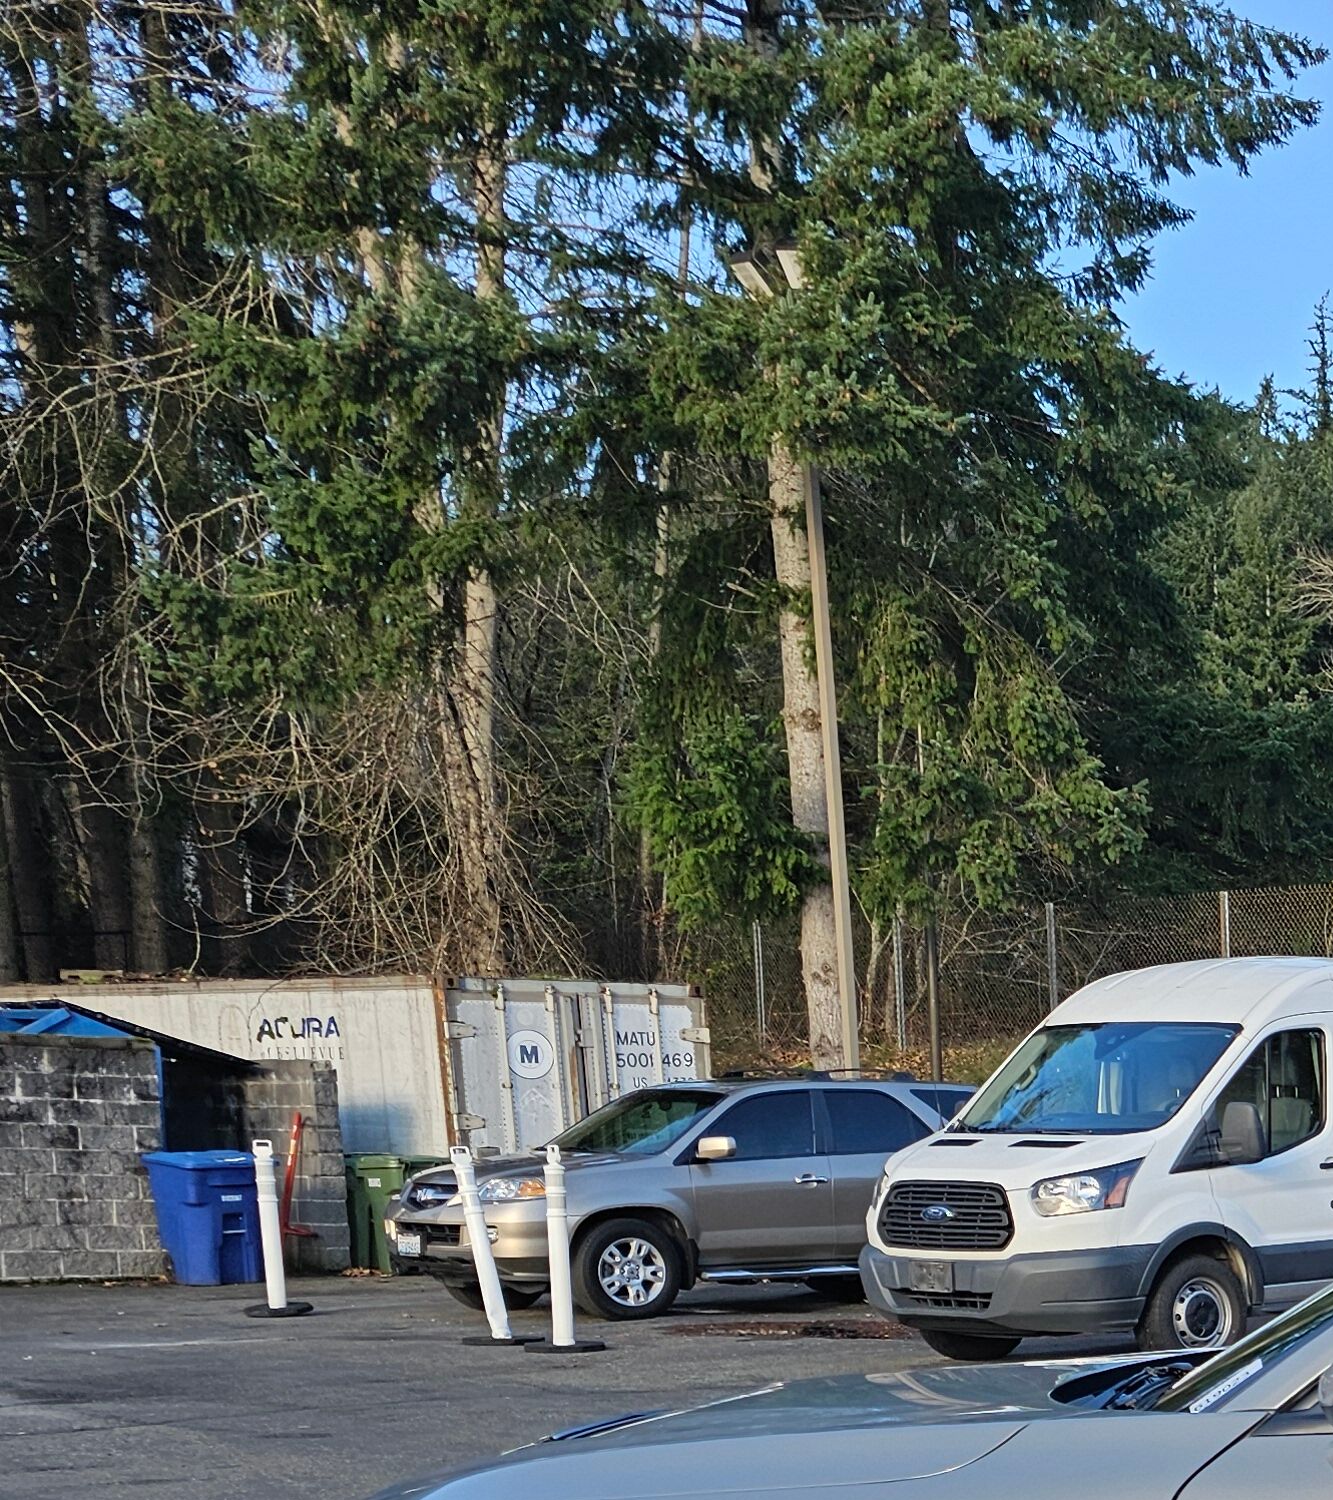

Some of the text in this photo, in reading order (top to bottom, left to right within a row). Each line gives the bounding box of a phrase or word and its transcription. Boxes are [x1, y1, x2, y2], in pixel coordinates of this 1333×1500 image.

[256, 1016, 340, 1043] ACURA
[616, 1030, 656, 1046] MATU
[519, 1044, 540, 1064] M
[662, 1052, 694, 1068] 469
